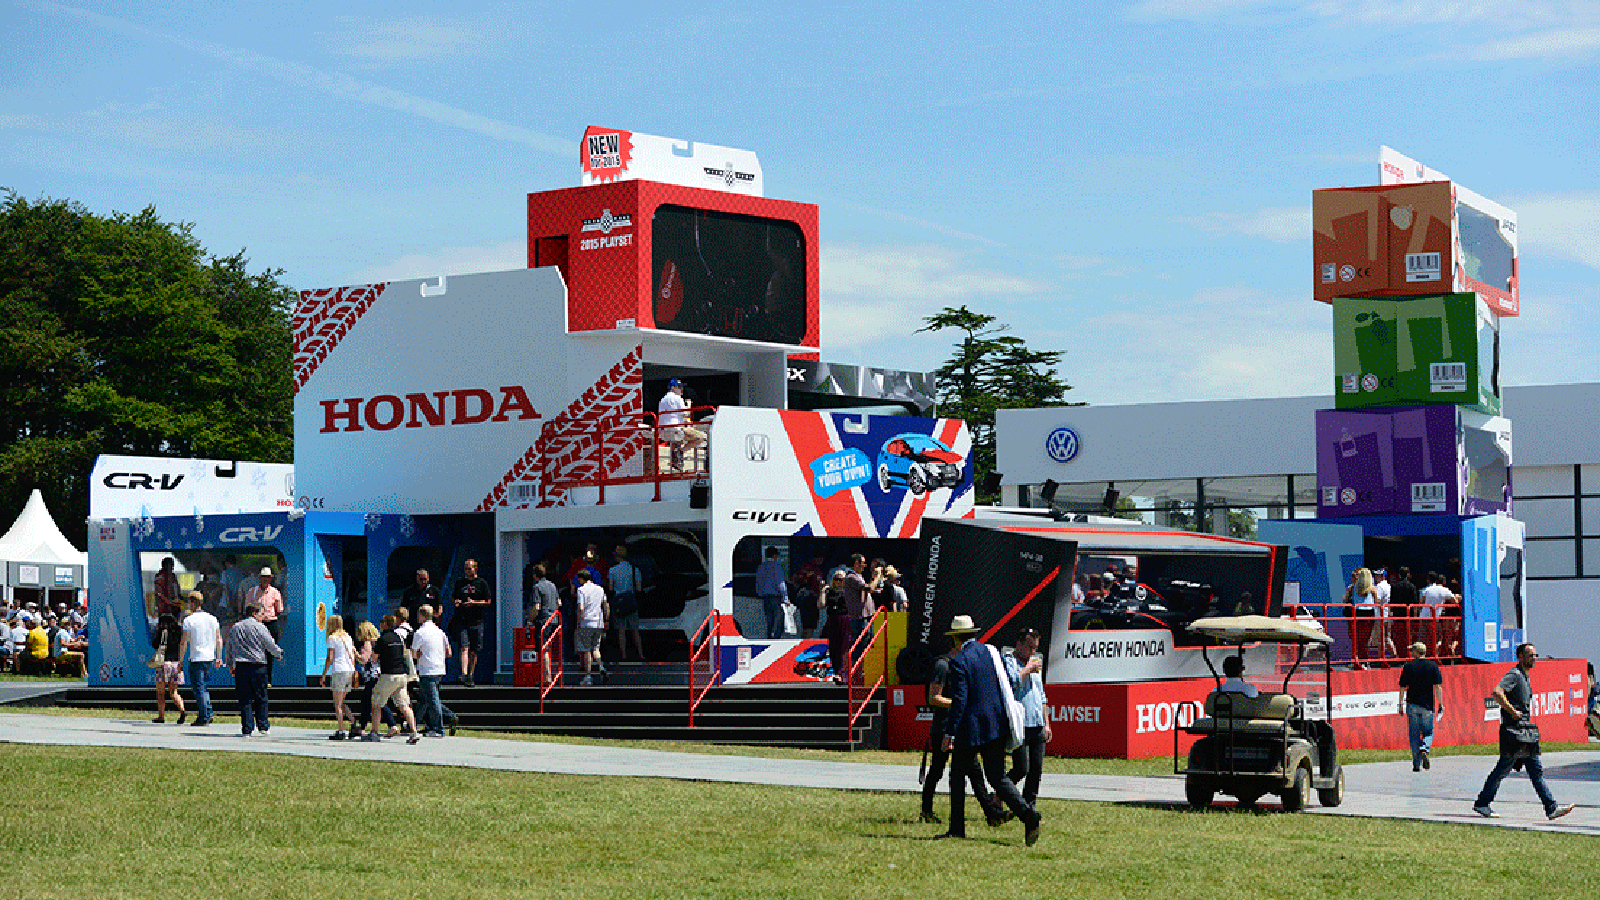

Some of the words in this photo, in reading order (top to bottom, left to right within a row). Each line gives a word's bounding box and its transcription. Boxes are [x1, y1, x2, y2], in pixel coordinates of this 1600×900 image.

[589, 135, 618, 155] NEW
[603, 155, 620, 167] 2015
[580, 238, 599, 250] 2015
[600, 234, 633, 248] PLAYSET
[320, 385, 541, 434] HONDA
[823, 453, 856, 473] CREATE
[103, 472, 185, 490] CR-V
[817, 472, 842, 487] YOUR
[732, 510, 797, 523] CIVIC
[218, 525, 284, 543] CR-V
[927, 535, 942, 581] HONDA
[920, 583, 936, 644] McLAREN
[1065, 641, 1122, 659] McLAREN
[1125, 640, 1165, 657] HONDA
[1136, 700, 1212, 733] HOND
